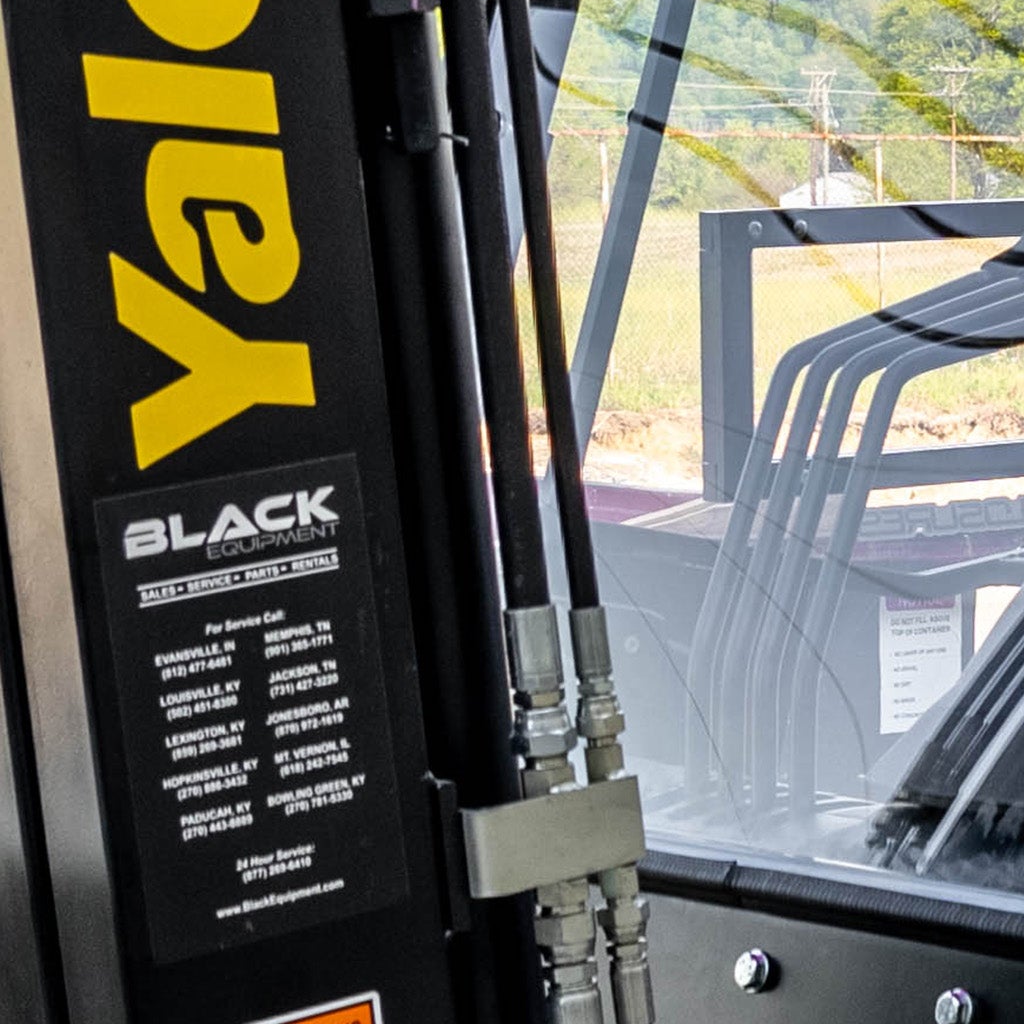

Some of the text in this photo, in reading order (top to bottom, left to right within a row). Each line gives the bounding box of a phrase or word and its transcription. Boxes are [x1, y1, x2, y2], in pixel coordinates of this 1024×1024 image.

[123, 485, 339, 559] BLACK
[206, 521, 339, 559] EQUIPMENT
[140, 553, 339, 603] SALES SERVICE PARTS RENTALS
[205, 623, 223, 636] For
[224, 615, 262, 632] Service
[263, 620, 331, 643] MEMPHIS, TN
[154, 640, 236, 667] EVANSVILLE, IN
[268, 659, 337, 684] JACKSON, TN
[159, 679, 240, 707] LOUISVILLE, KY
[265, 696, 349, 726] JONESBORO, AR
[165, 719, 245, 748] LEXINGTON, KY
[292, 740, 339, 760] VERNON,
[162, 758, 258, 790] HOPKINSVILLE, KY
[266, 786, 315, 807] BOWLING
[351, 773, 365, 786] KY
[180, 800, 251, 827] PADUCAH, KY
[249, 853, 275, 867] Hour
[216, 878, 344, 919] www.BlackEquipment.com
